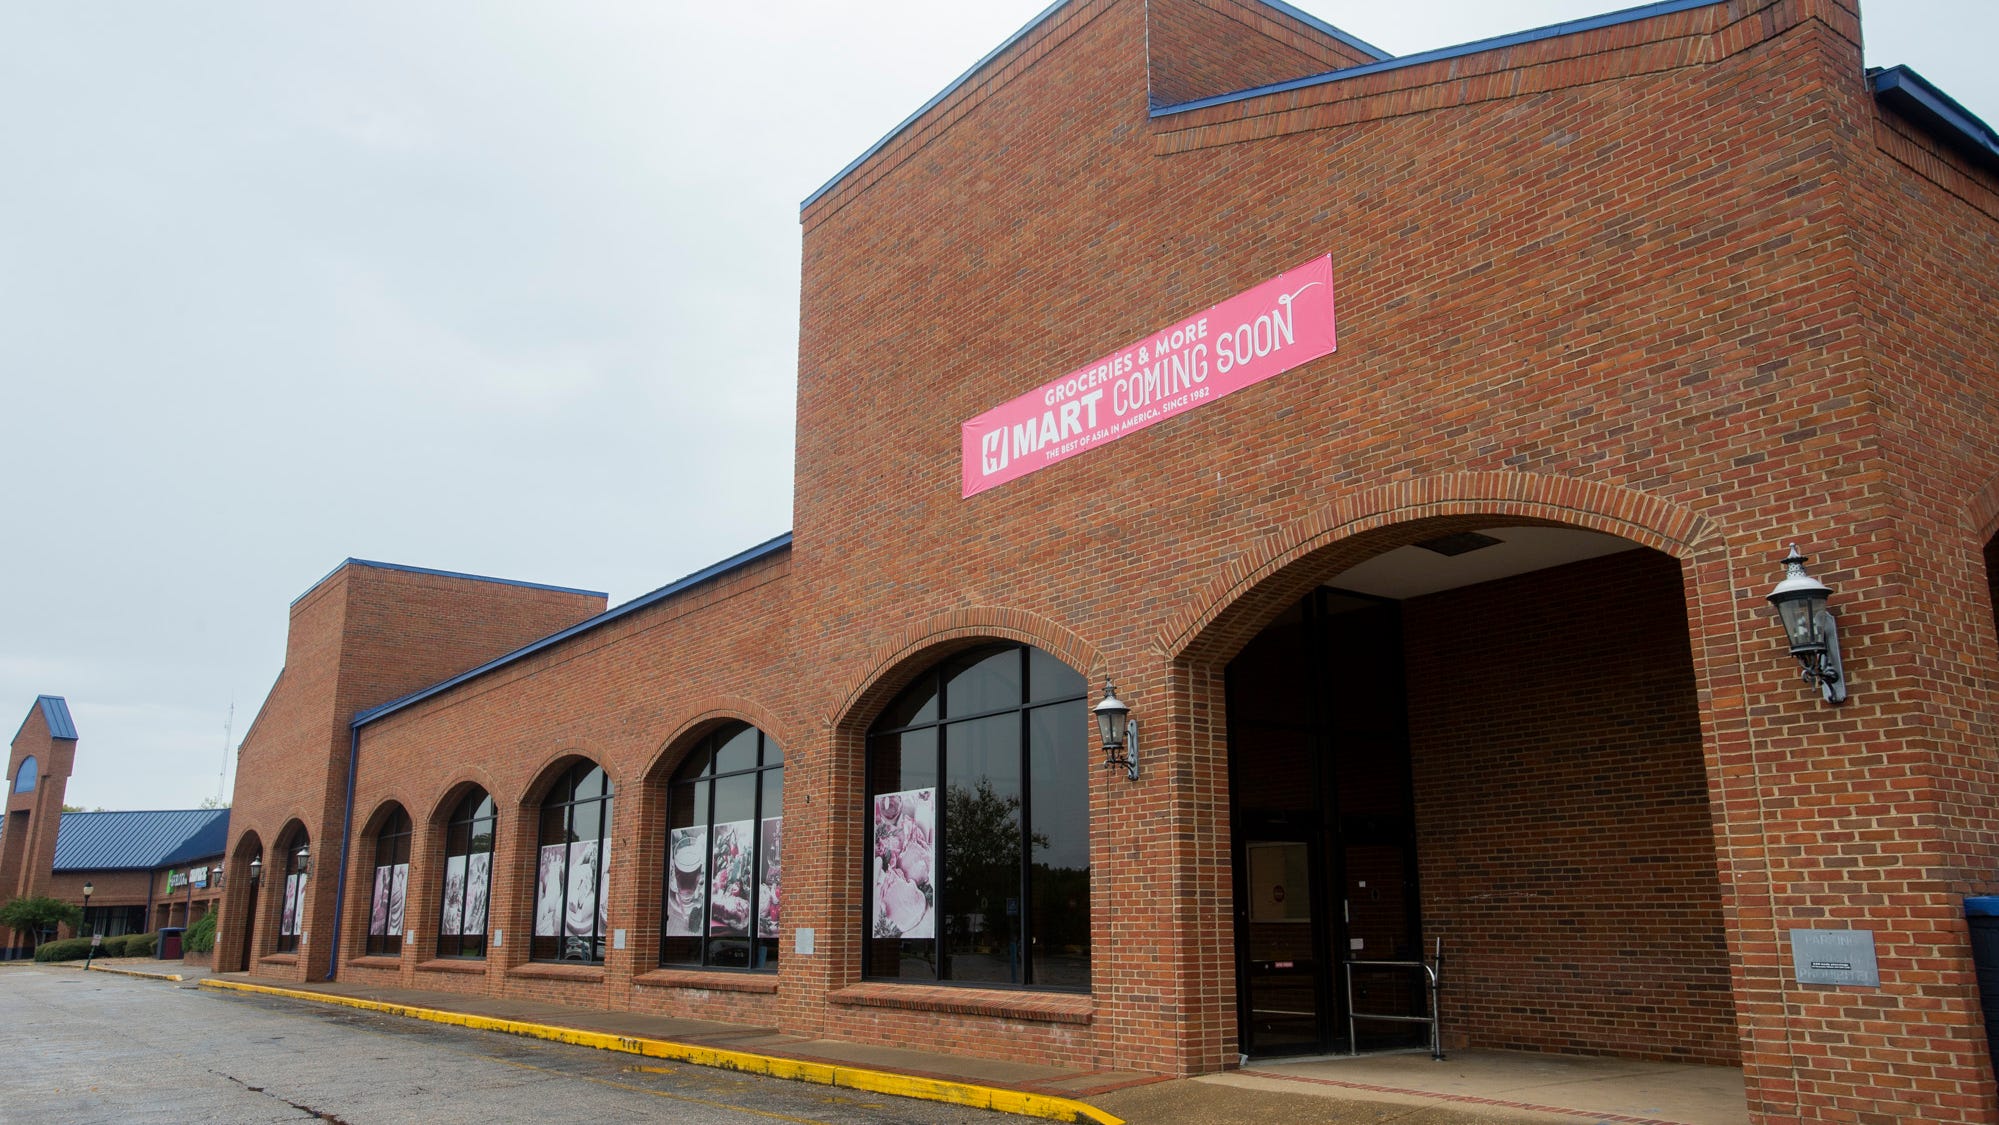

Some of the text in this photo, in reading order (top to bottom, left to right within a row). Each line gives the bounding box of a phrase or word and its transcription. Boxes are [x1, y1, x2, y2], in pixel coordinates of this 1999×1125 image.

[1012, 387, 1104, 460] MART
[1113, 343, 1209, 417] COMING
[1215, 281, 1324, 374] SOON
[1044, 317, 1208, 407] GROCERIES & MORE
[1045, 386, 1211, 460] THE BEST OF ASIA IN AMERICA. SINCE 1982
